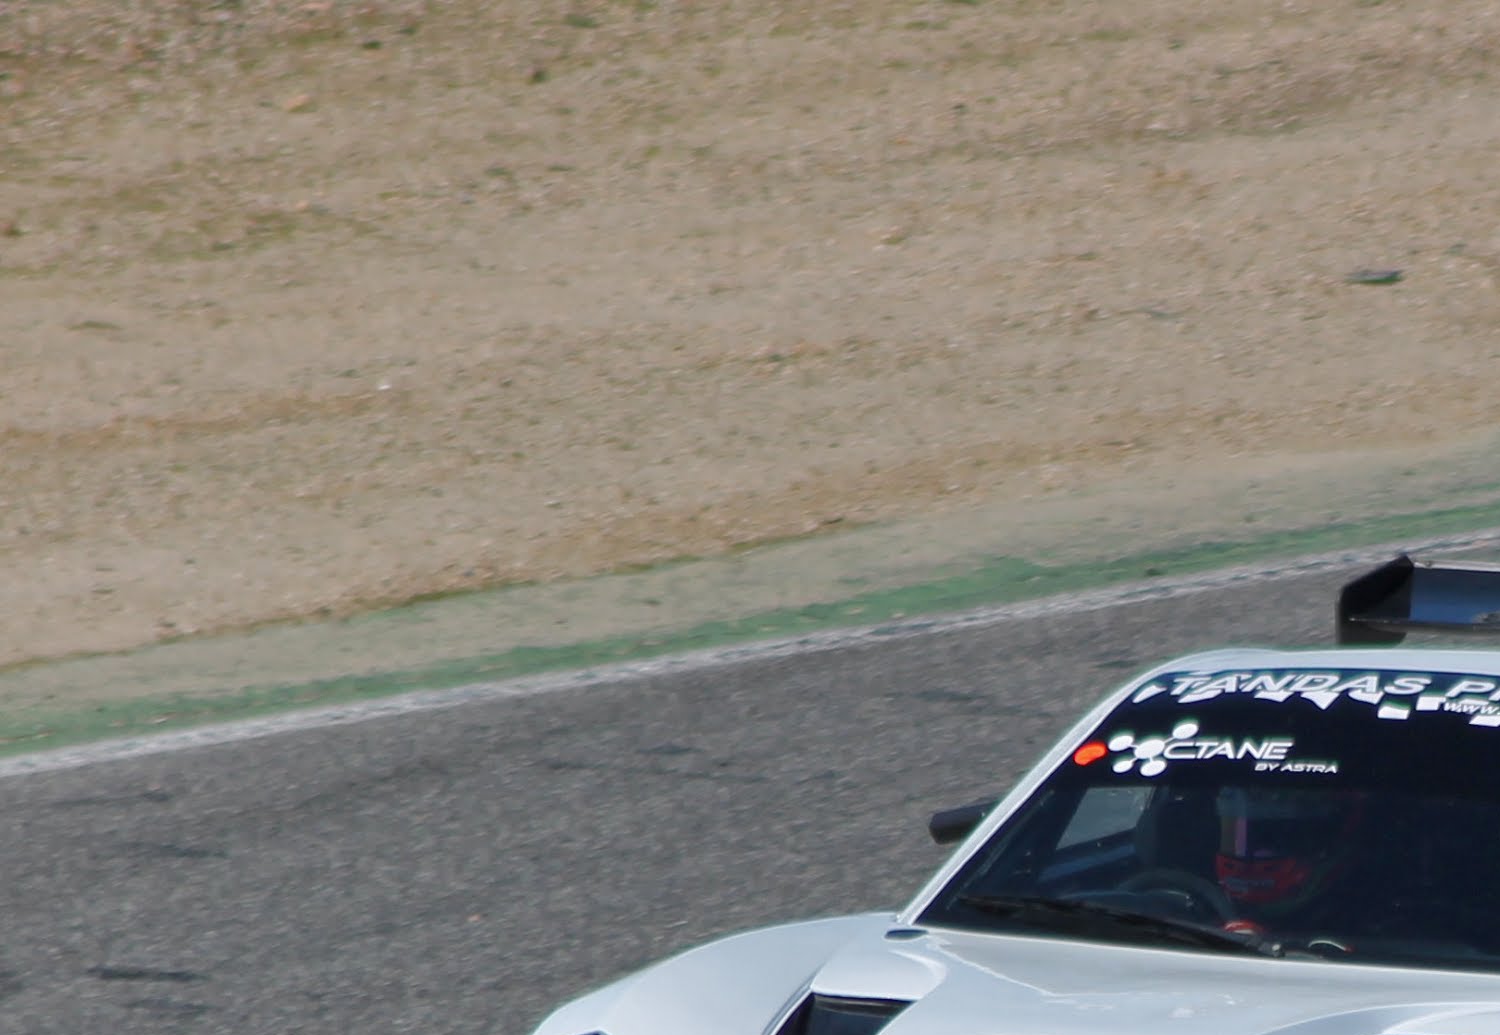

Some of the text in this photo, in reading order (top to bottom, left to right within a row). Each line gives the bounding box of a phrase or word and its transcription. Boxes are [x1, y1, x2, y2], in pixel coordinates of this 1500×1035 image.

[1169, 673, 1432, 697] TANDAS
[1255, 762, 1338, 774] BY ASTRA
